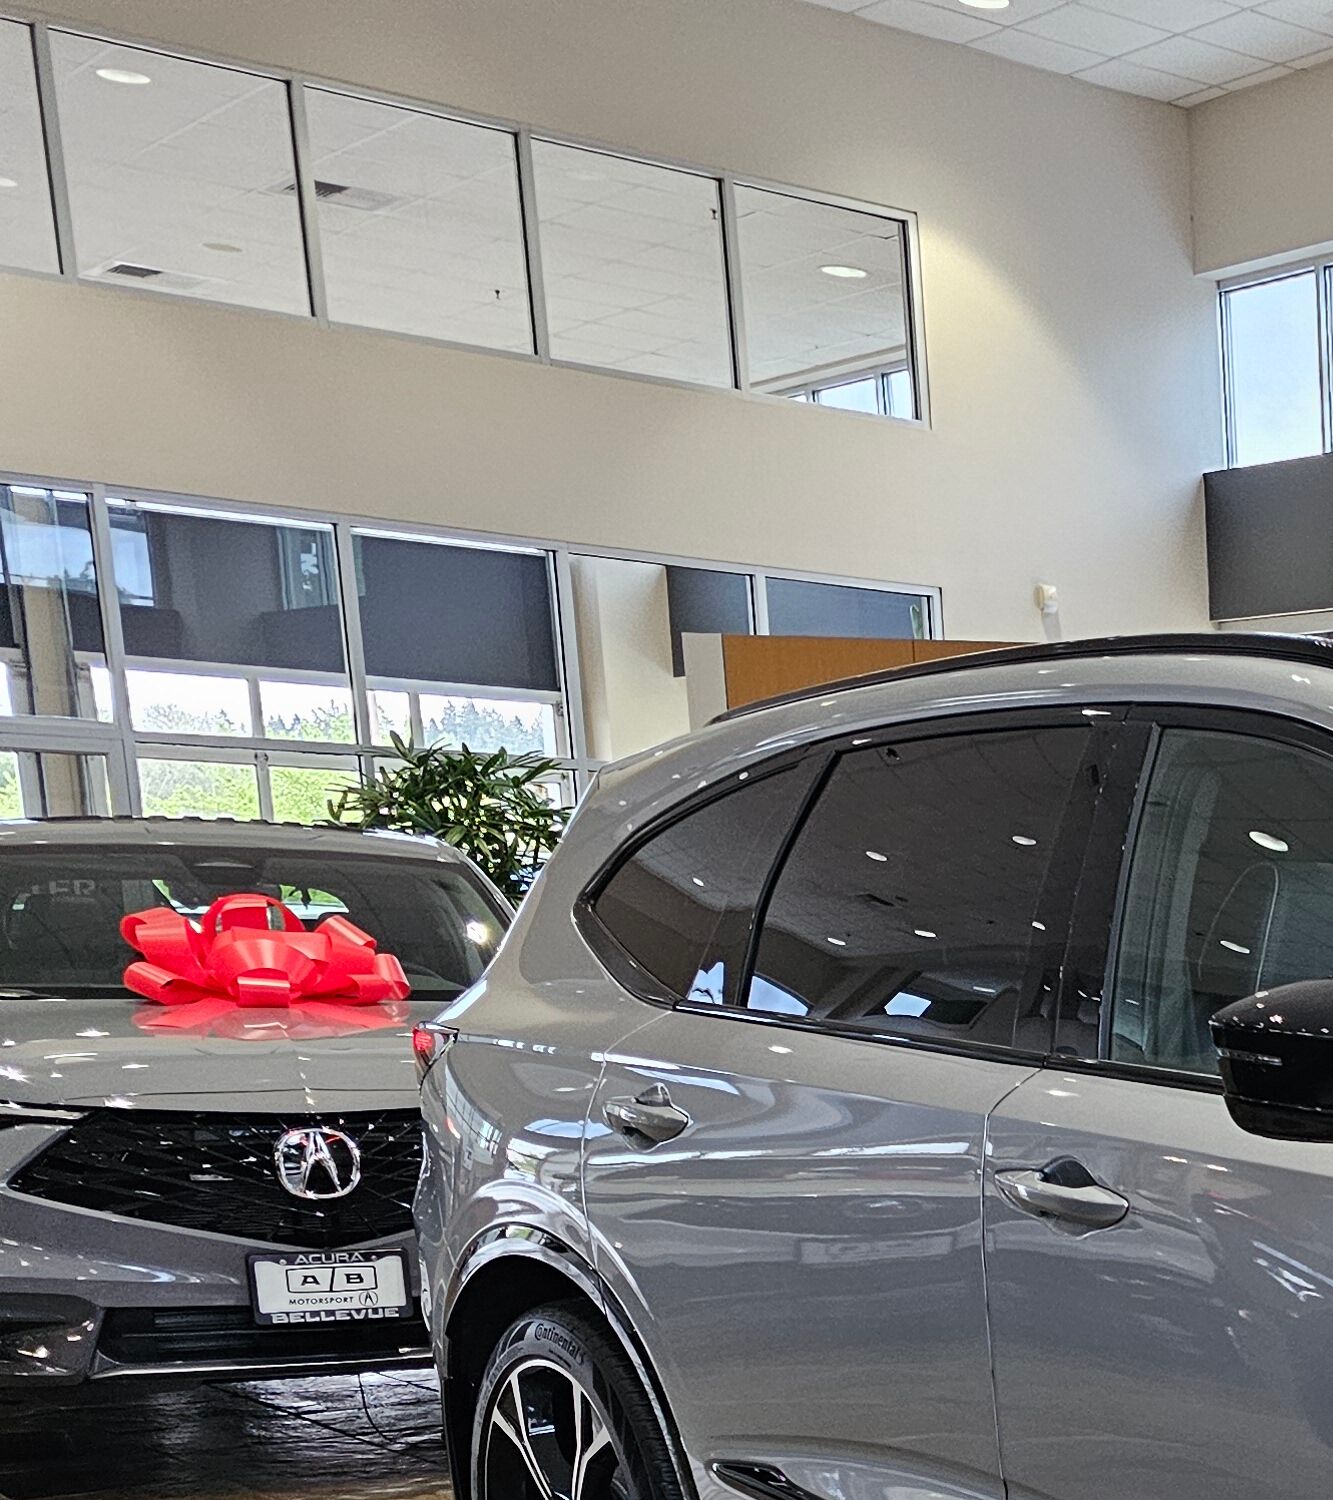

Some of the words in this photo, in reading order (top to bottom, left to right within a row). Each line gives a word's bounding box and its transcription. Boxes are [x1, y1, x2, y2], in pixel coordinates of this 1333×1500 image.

[294, 1252, 365, 1265] ACURA
[301, 1275, 321, 1286] A
[344, 1273, 364, 1284] B
[289, 1296, 354, 1305] MOTORSPORT
[270, 1307, 400, 1324] BELLEVUE
